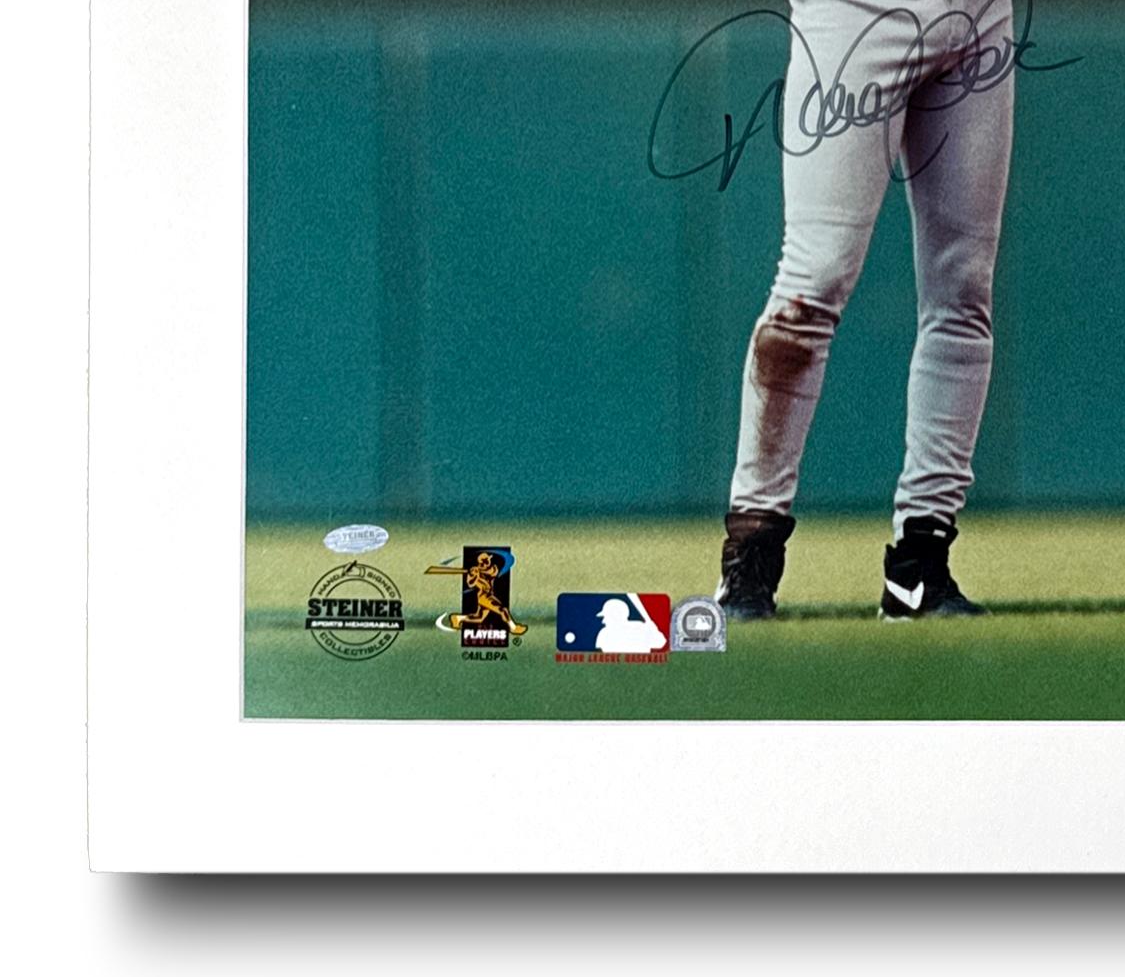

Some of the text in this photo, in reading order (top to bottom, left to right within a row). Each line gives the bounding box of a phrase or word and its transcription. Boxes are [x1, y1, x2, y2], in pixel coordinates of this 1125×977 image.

[307, 598, 402, 618] STEINER
[319, 631, 392, 656] COLLECTIBLES
[463, 629, 507, 640] PLAYERS
